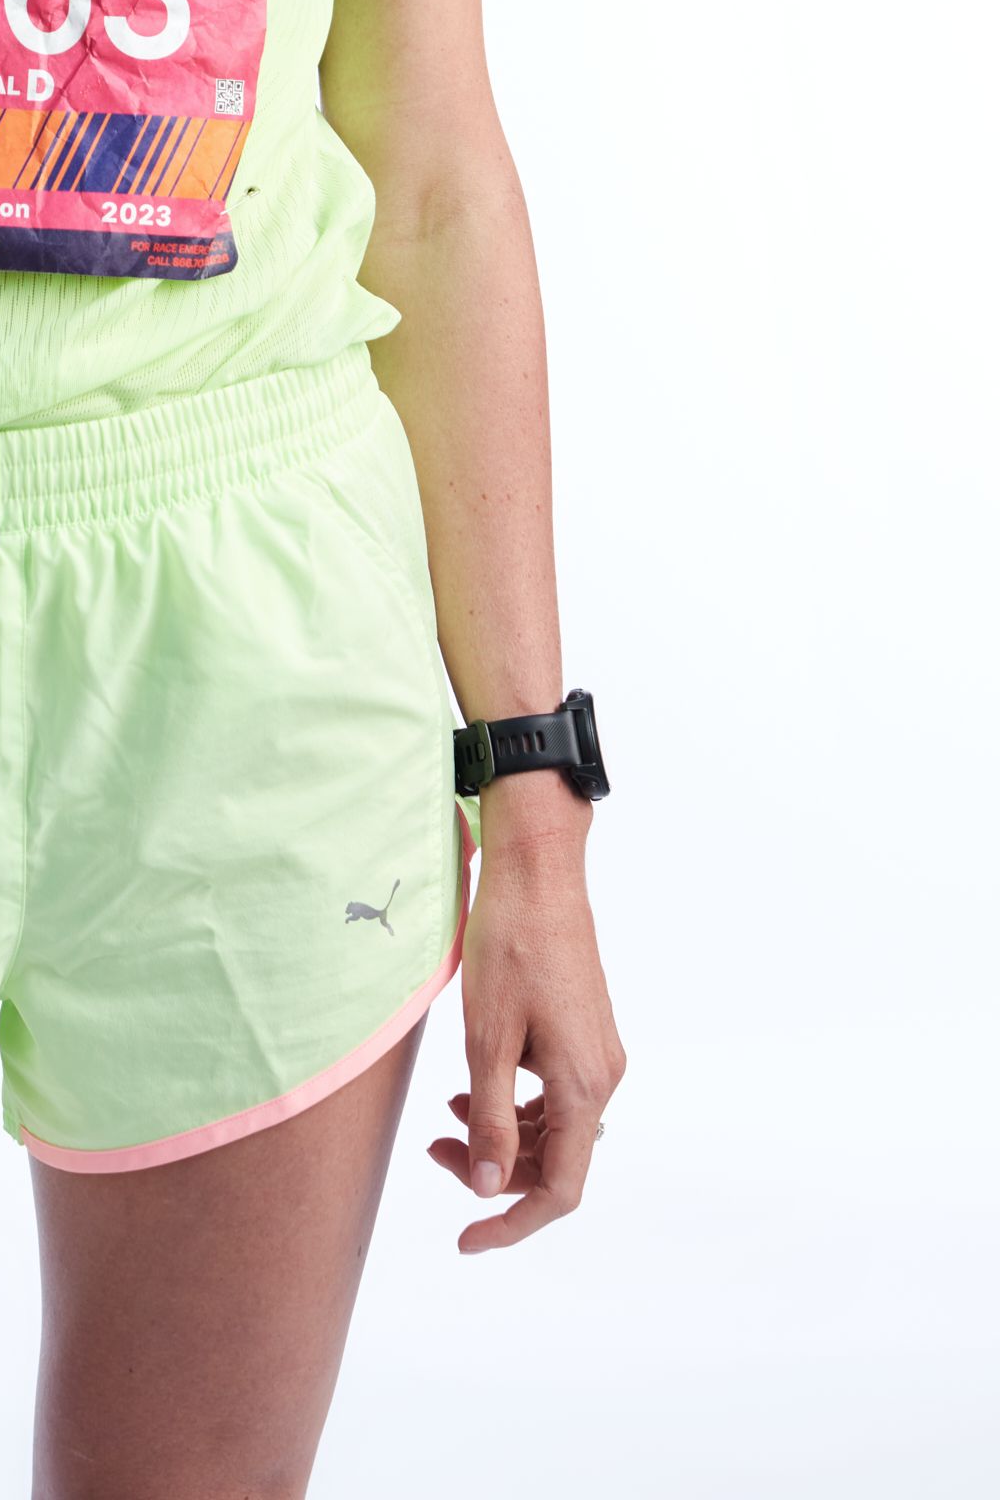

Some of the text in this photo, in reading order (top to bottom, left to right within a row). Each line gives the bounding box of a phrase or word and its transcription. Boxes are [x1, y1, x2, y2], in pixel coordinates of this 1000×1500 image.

[27, 69, 55, 102] D
[101, 202, 172, 227] 2023
[131, 241, 150, 252] FOR
[153, 243, 178, 253] RACE
[147, 255, 169, 266] CALL
